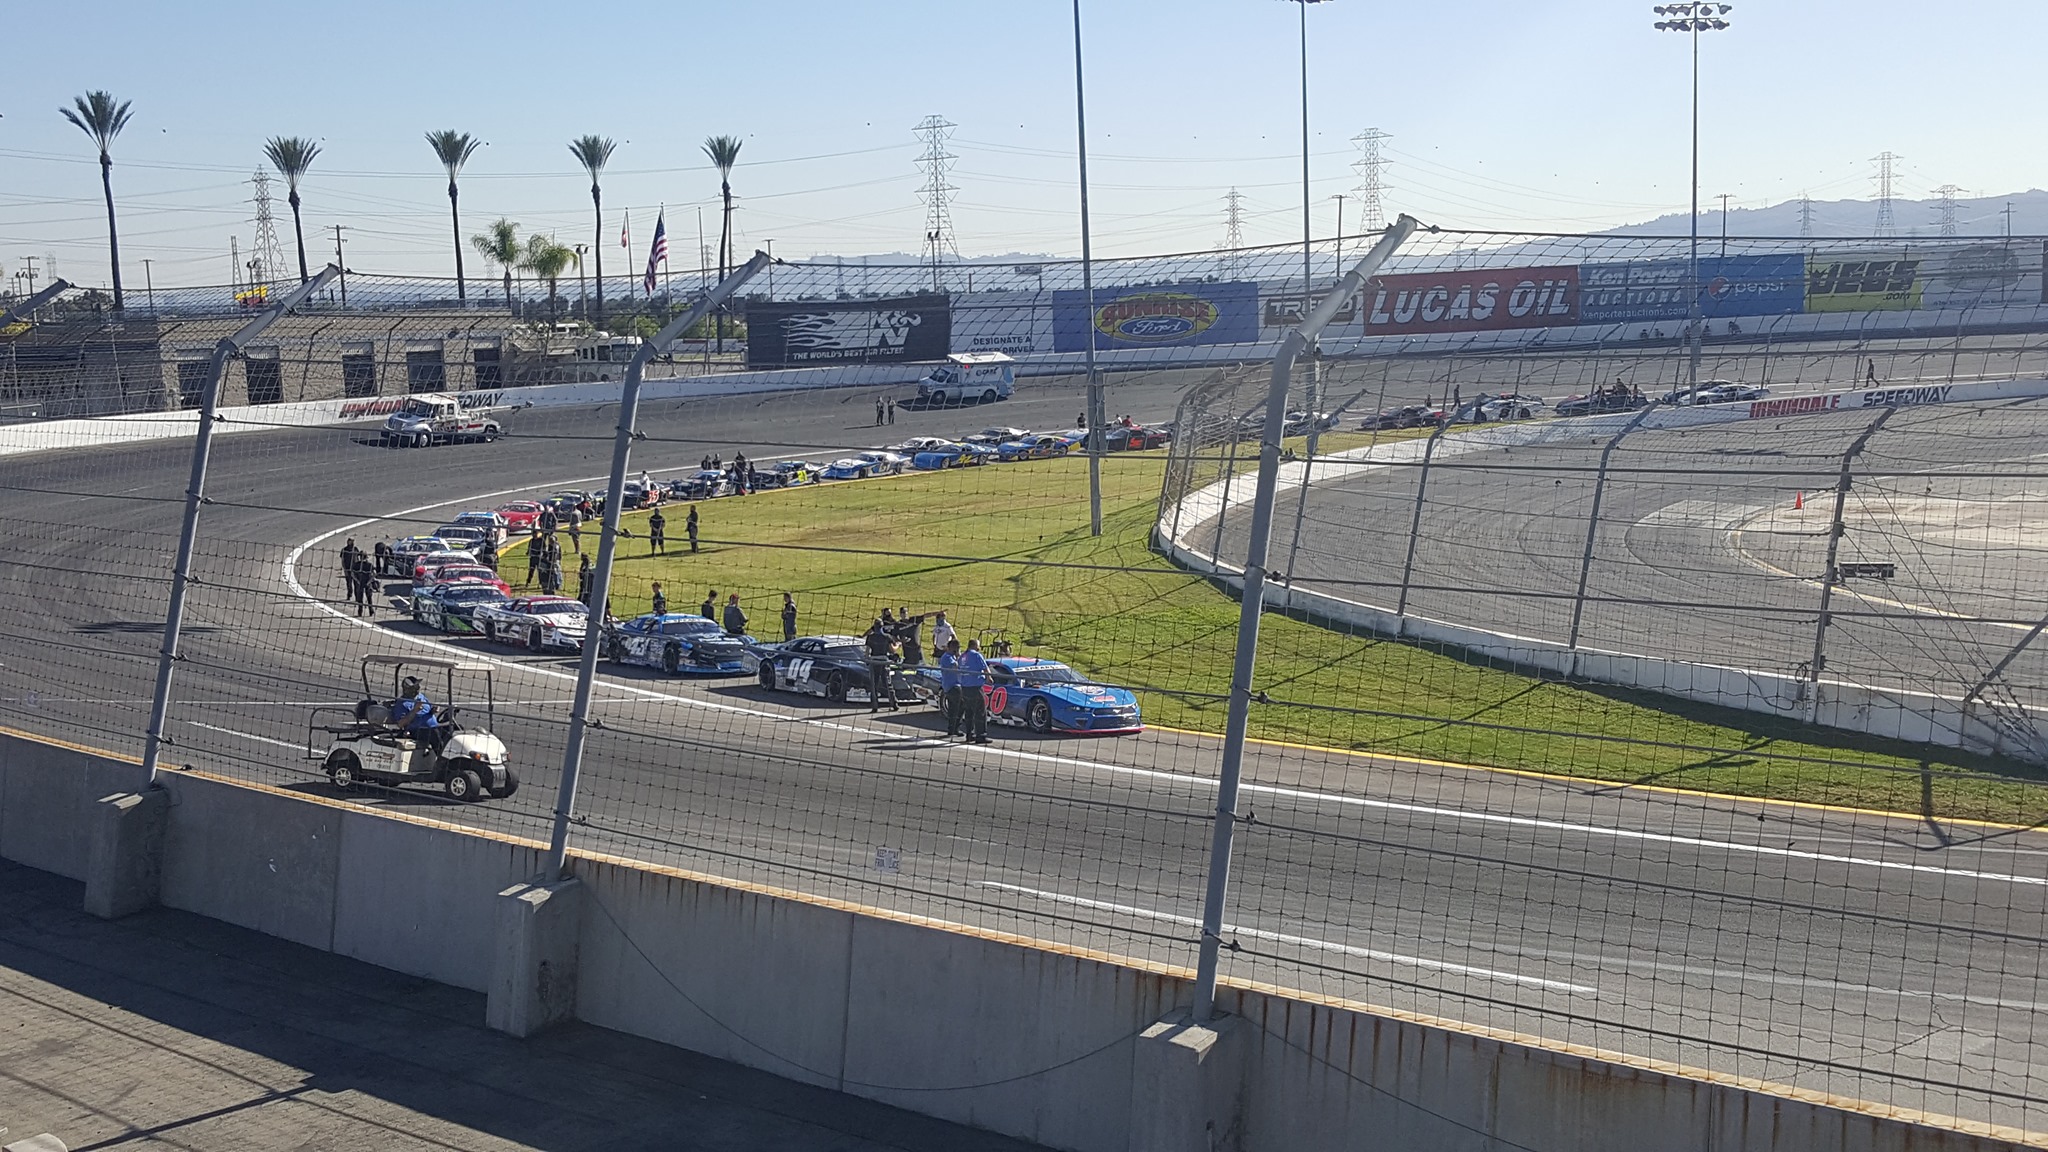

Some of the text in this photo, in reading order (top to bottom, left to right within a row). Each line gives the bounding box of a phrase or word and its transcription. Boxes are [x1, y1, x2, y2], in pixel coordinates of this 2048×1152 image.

[1587, 267, 1685, 285] Ken Porter
[1735, 277, 1784, 297] pepsi
[1369, 280, 1571, 325] LUCAS OIL
[1585, 290, 1682, 307] AUCTIONS
[1131, 318, 1183, 334] Ford
[973, 336, 1022, 346] DESIGNATE
[793, 352, 809, 360] THE
[1863, 386, 1953, 408] SPEEDWAY
[1749, 395, 1841, 418] IRWINDALE
